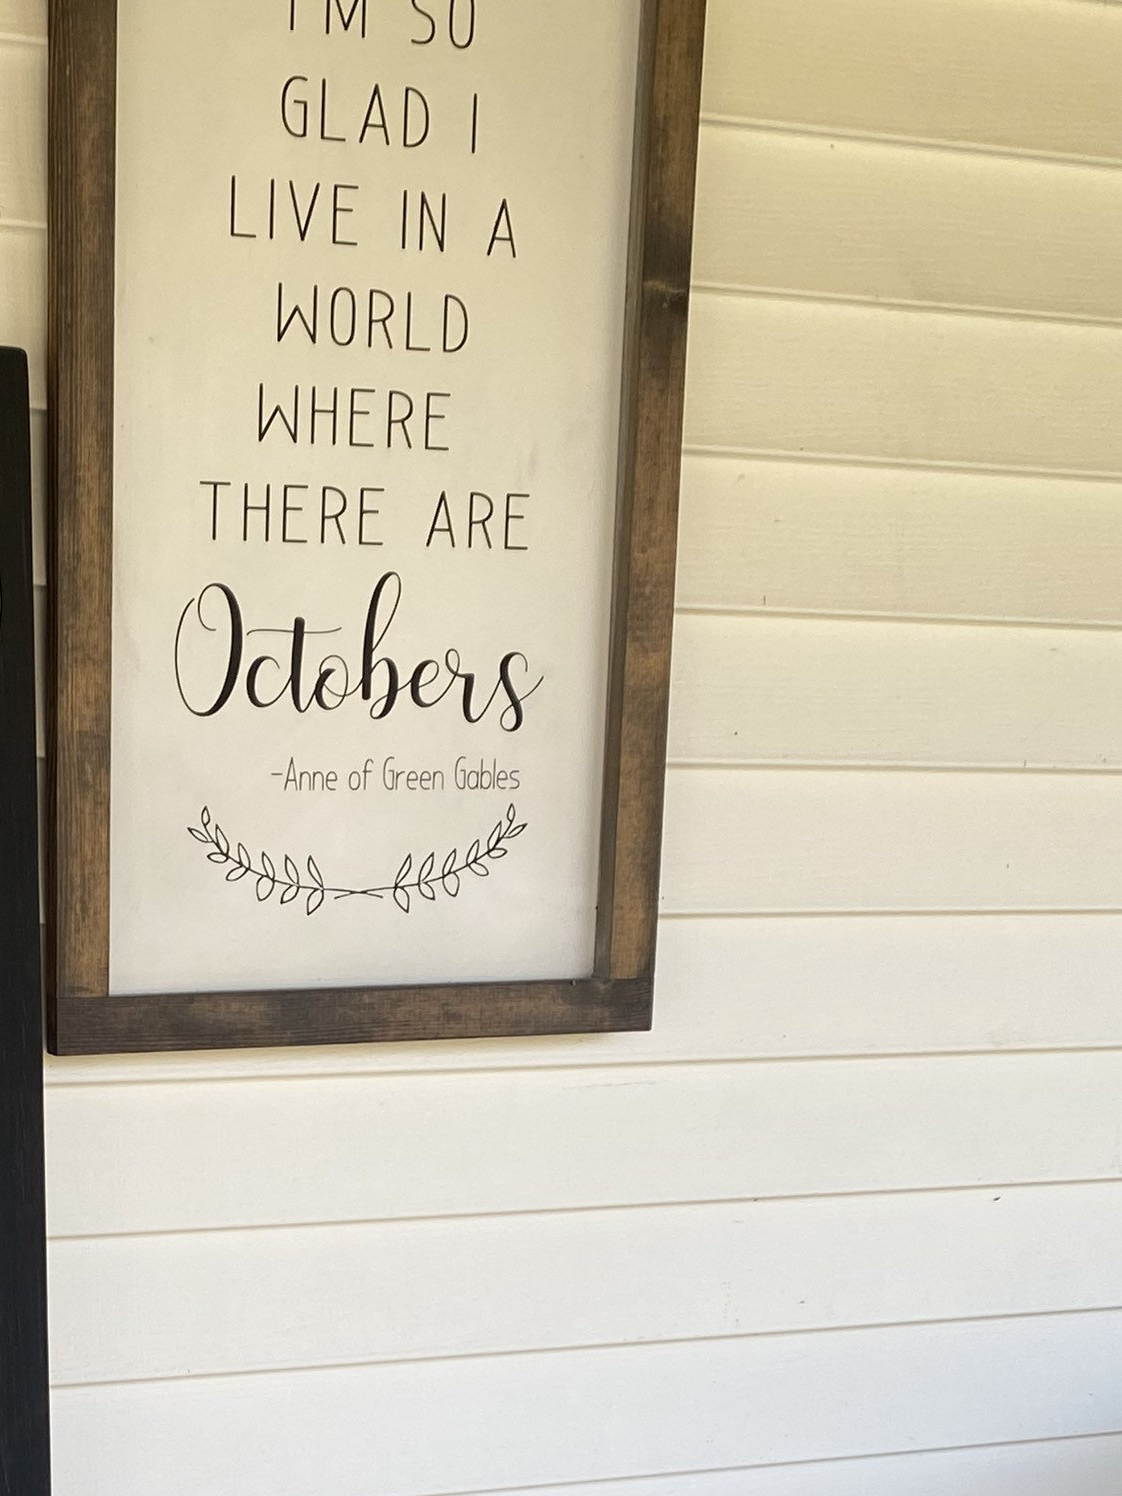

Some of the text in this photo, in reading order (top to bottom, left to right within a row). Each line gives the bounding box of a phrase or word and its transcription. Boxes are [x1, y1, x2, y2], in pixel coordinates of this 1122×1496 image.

[289, 0, 476, 49] IM SO
[280, 75, 479, 155] GLAD I
[229, 174, 518, 259] LIVE IN A
[276, 281, 470, 354] WORLD
[257, 382, 453, 452] WHERE
[198, 480, 532, 551] THERE ARE
[174, 570, 545, 733] Octobers
[270, 755, 521, 792] -Anne of Green Gables
